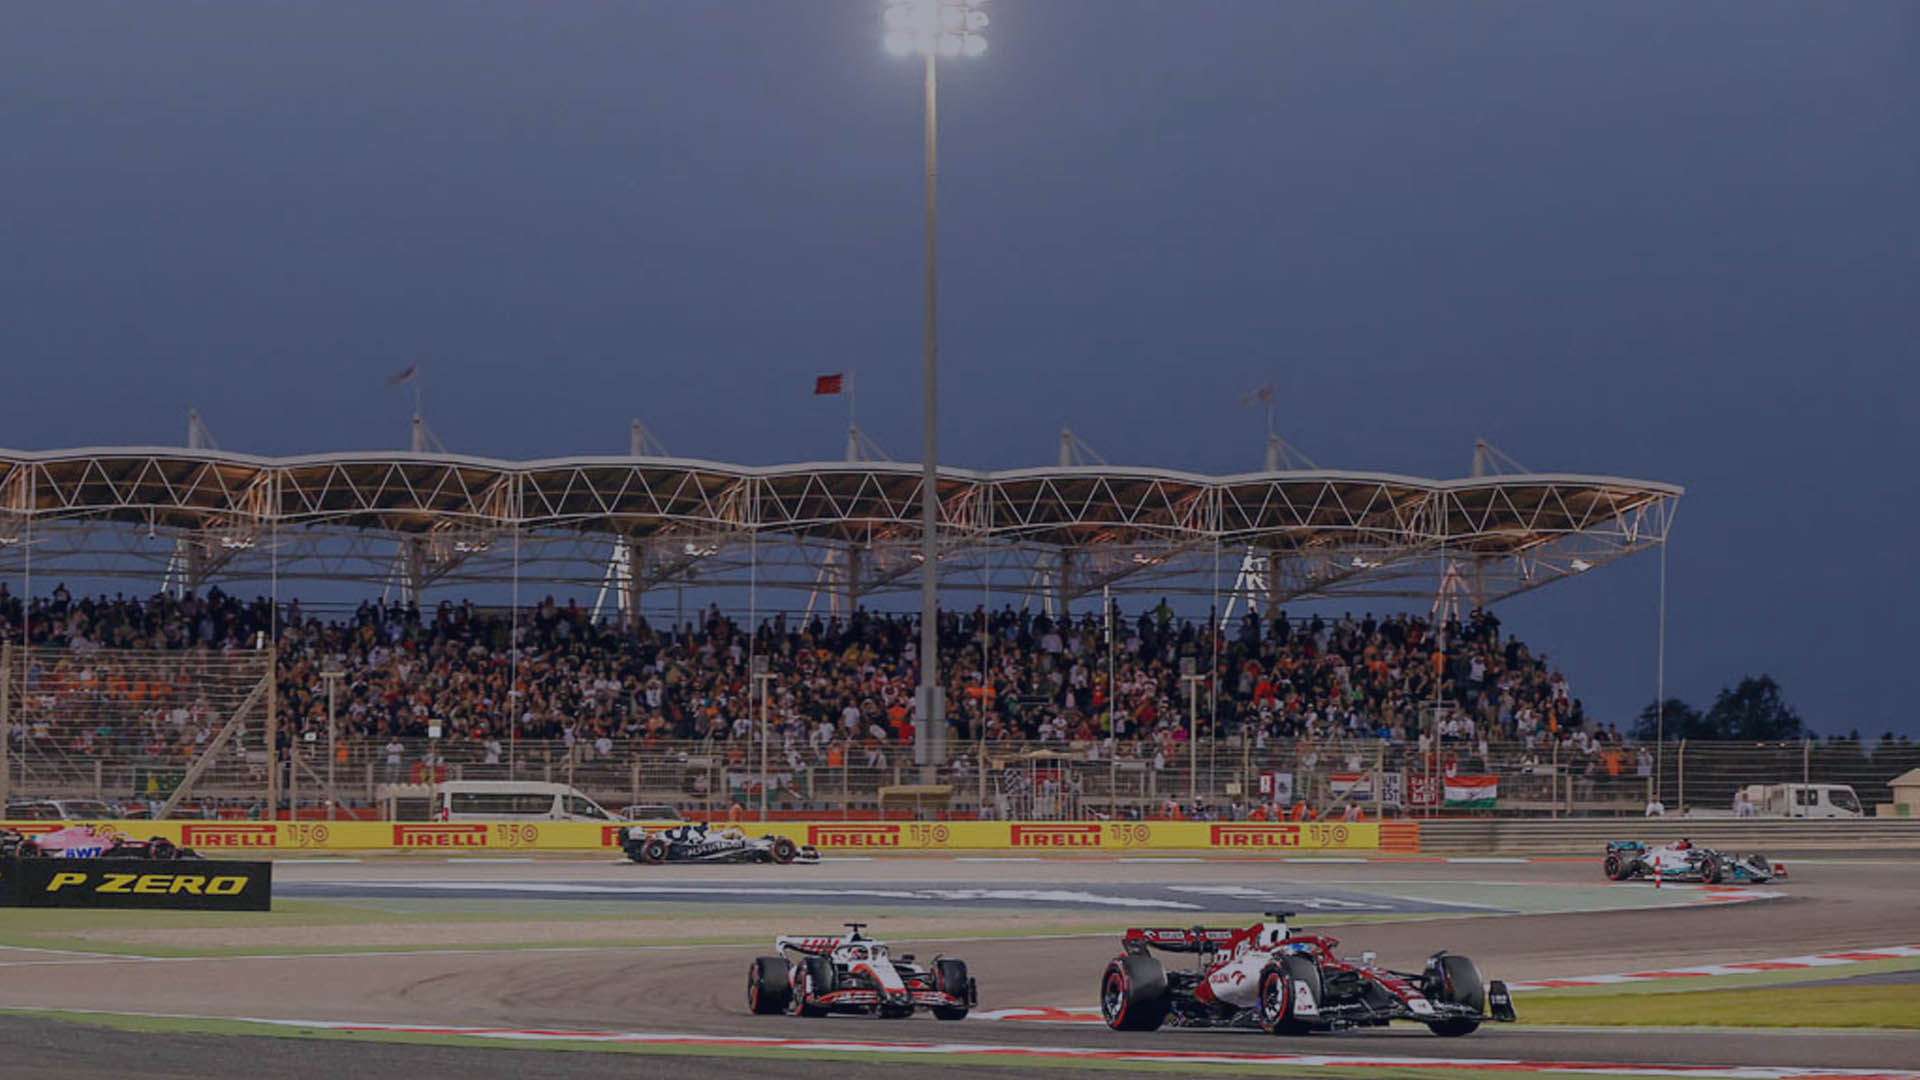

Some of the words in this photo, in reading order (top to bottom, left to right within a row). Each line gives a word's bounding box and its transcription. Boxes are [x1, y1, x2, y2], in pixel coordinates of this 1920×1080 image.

[181, 824, 276, 846] PIRELLI
[393, 824, 488, 846] PIRELLI
[808, 824, 900, 846] PIRELLI
[1010, 824, 1102, 846] PIRELLI
[1211, 824, 1300, 846] PIRELLI
[65, 847, 102, 859] BWT
[46, 872, 88, 892] P
[95, 874, 249, 895] ZERO
